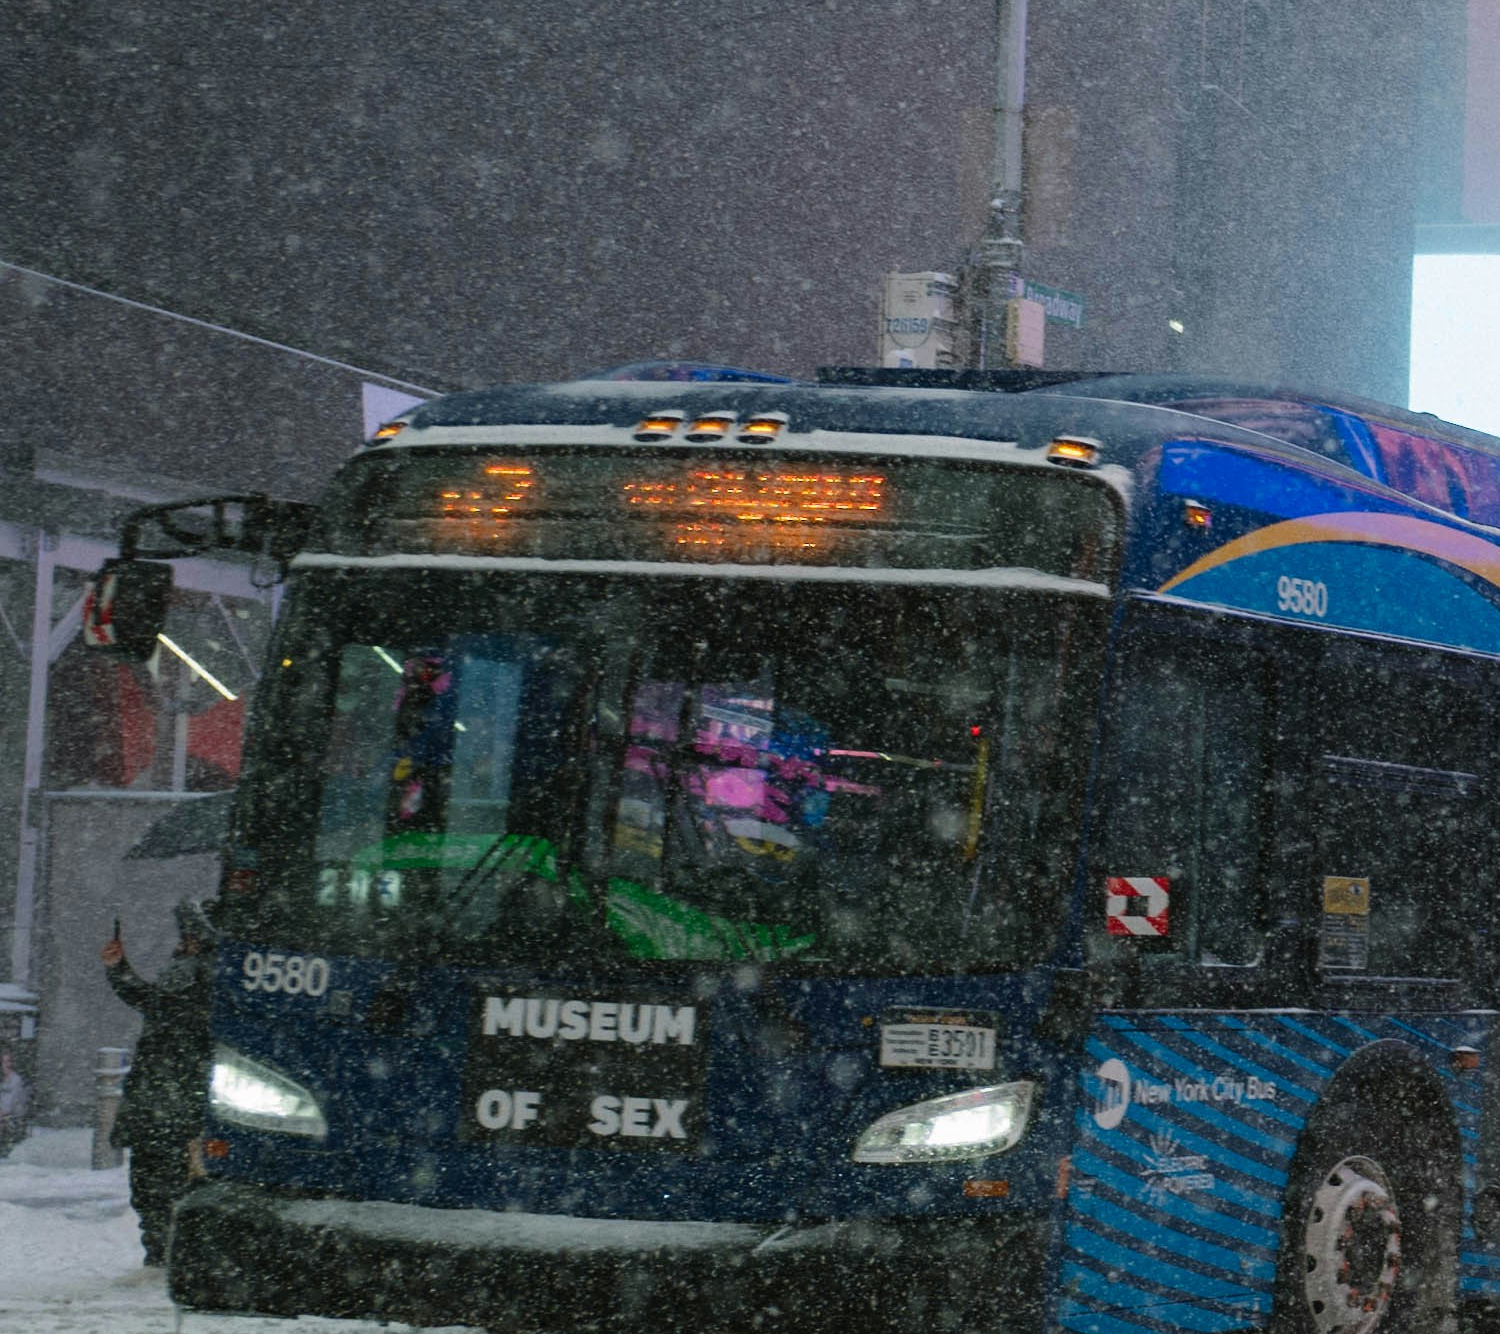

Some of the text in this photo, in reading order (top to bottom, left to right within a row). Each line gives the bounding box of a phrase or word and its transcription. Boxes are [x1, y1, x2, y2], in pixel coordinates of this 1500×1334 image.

[1276, 575, 1329, 618] 9580
[243, 950, 330, 999] 9580
[482, 996, 698, 1047] MUSEUM
[477, 1087, 689, 1140] OF SEX
[1134, 1075, 1278, 1105] New York City Bus
